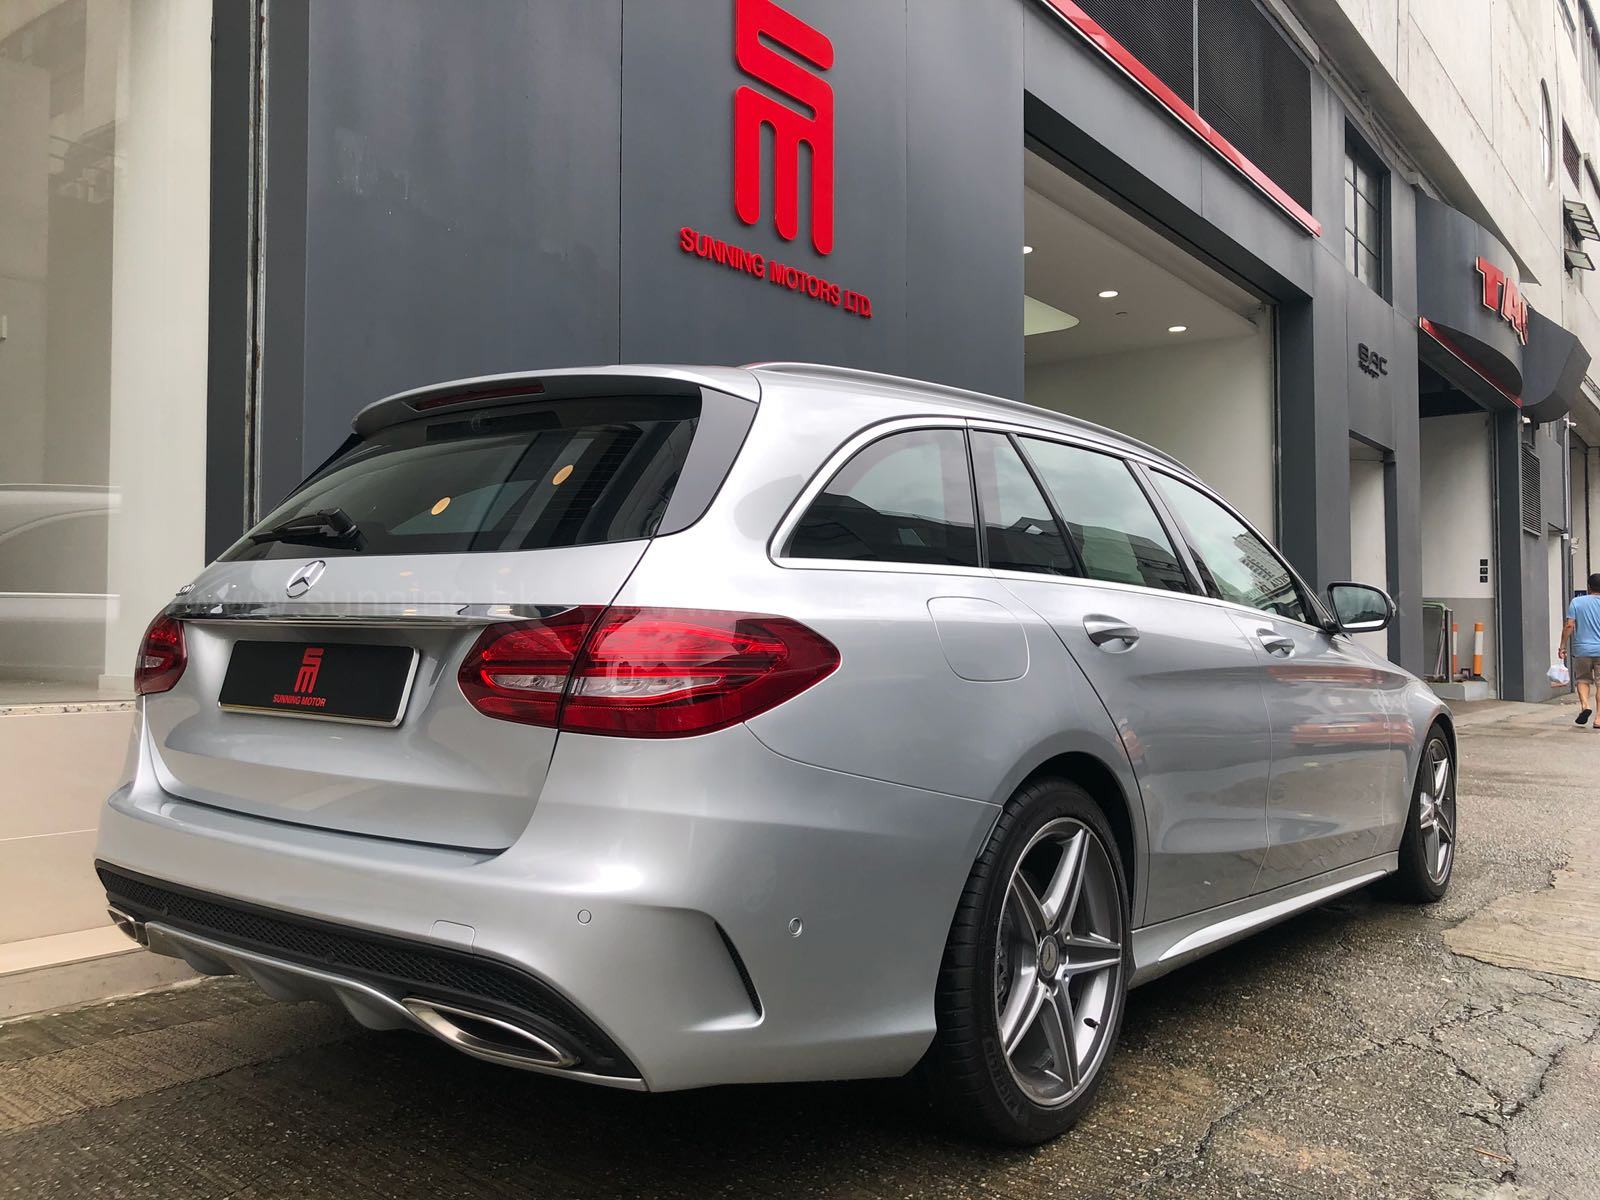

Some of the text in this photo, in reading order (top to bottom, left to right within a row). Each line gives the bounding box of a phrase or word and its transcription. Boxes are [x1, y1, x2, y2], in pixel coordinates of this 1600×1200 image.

[679, 226, 765, 278] SUNNING
[769, 259, 841, 306] MOTORS
[1357, 343, 1388, 376] BAC
[272, 694, 327, 707] SUNNING MOTOR
